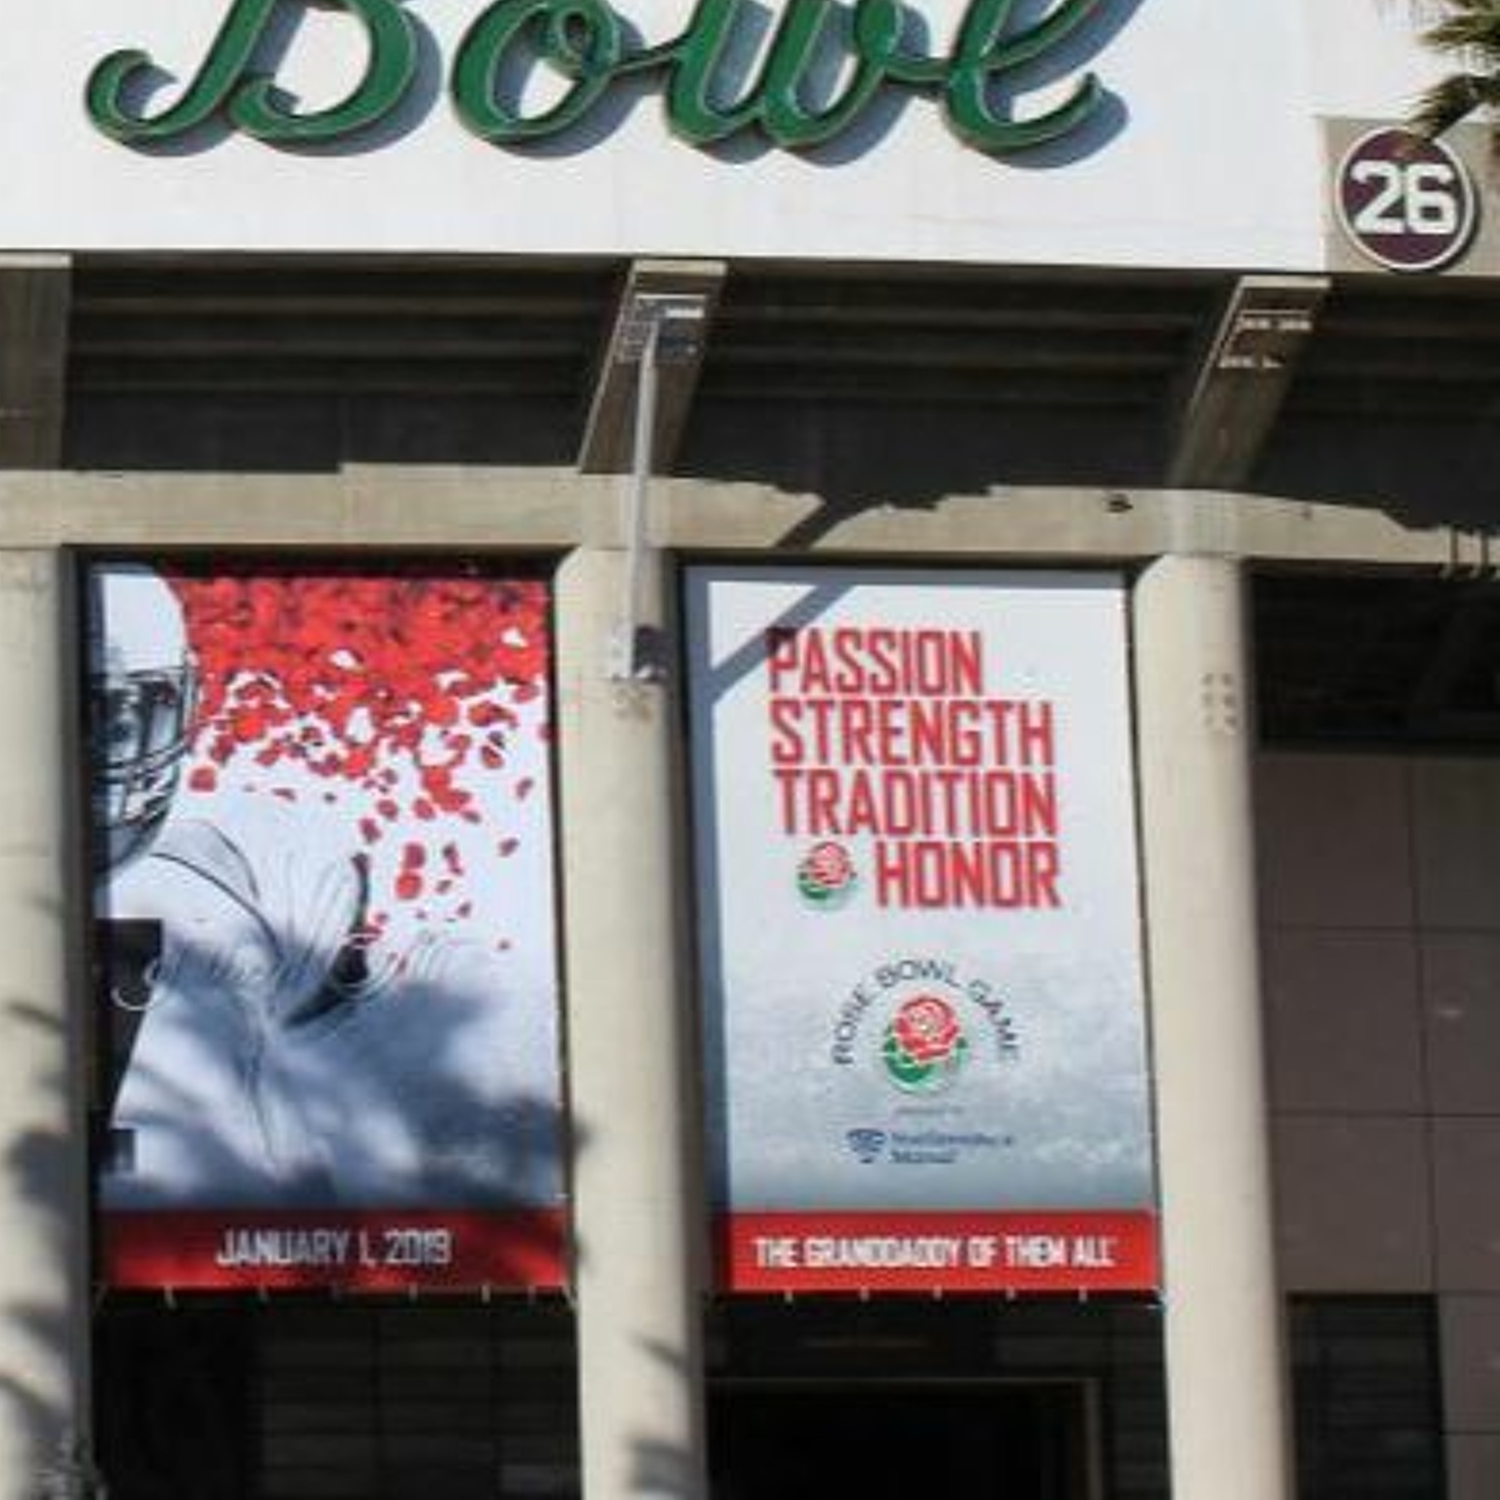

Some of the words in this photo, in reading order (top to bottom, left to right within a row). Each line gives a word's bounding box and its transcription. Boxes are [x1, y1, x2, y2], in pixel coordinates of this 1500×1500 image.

[1351, 159, 1457, 235] 26
[767, 626, 982, 696] PASSION
[769, 698, 1054, 767] STRENGTH
[774, 768, 1060, 838] TRADITION
[875, 839, 1062, 909] HONOR
[831, 983, 875, 1065] ROSE
[875, 959, 961, 989] BOWL
[968, 979, 1019, 1061] GAME
[216, 1228, 349, 1266] JANUARY
[383, 1227, 452, 1265] 2019
[754, 1236, 799, 1268] THE
[803, 1236, 961, 1268] GRANDDADDY
[967, 1236, 998, 1268] OF
[1005, 1236, 1067, 1268] THEM
[1071, 1236, 1116, 1268] ALL
